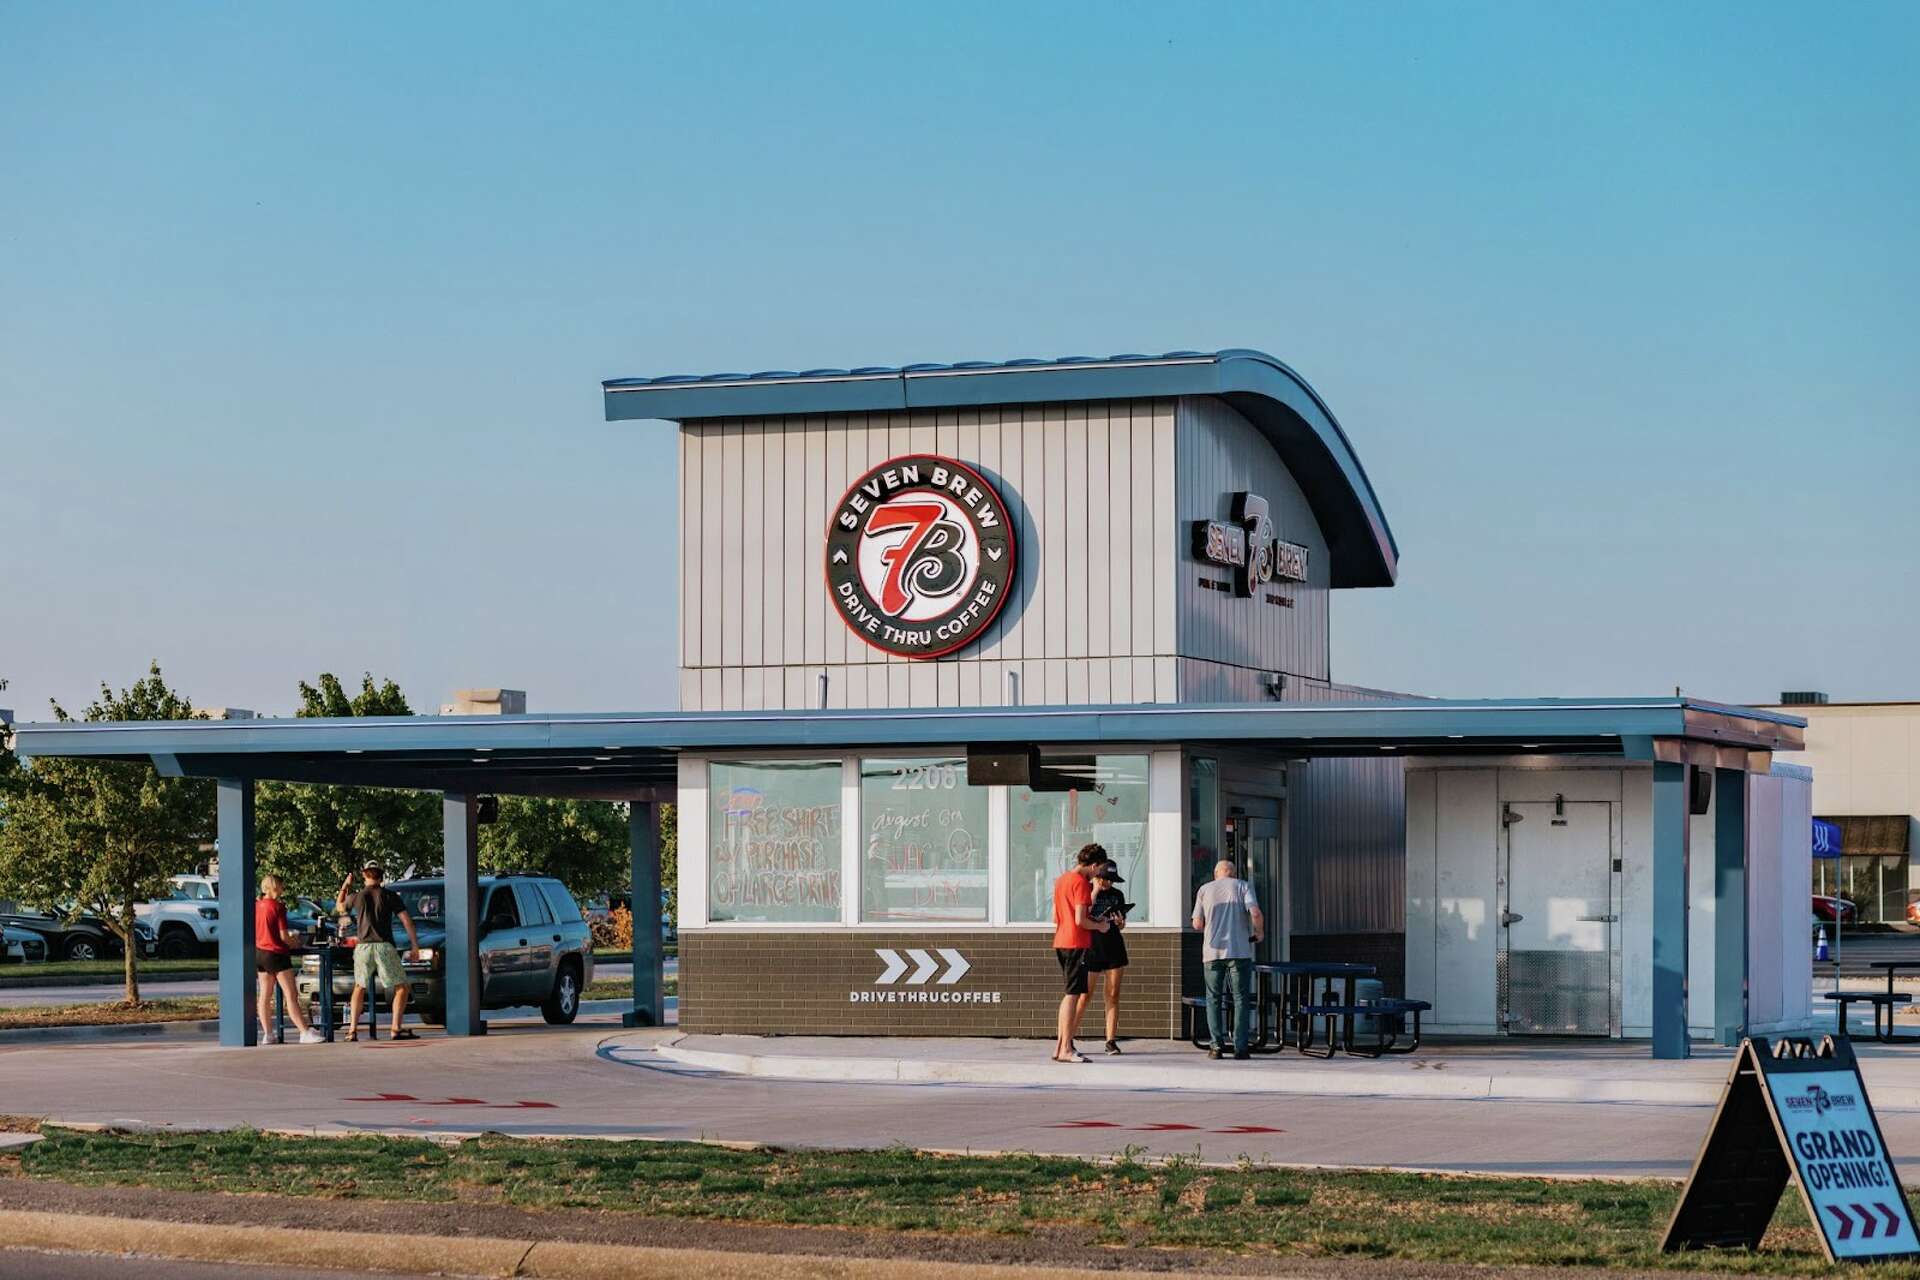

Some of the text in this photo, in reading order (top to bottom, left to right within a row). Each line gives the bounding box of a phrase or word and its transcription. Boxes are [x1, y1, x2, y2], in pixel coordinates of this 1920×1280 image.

[839, 465, 999, 530] SEVEN BREW
[838, 580, 997, 645] DRIVE THRU COFFEE
[1796, 1129, 1876, 1160] GRAND
[1807, 1160, 1890, 1191] OPENING!
